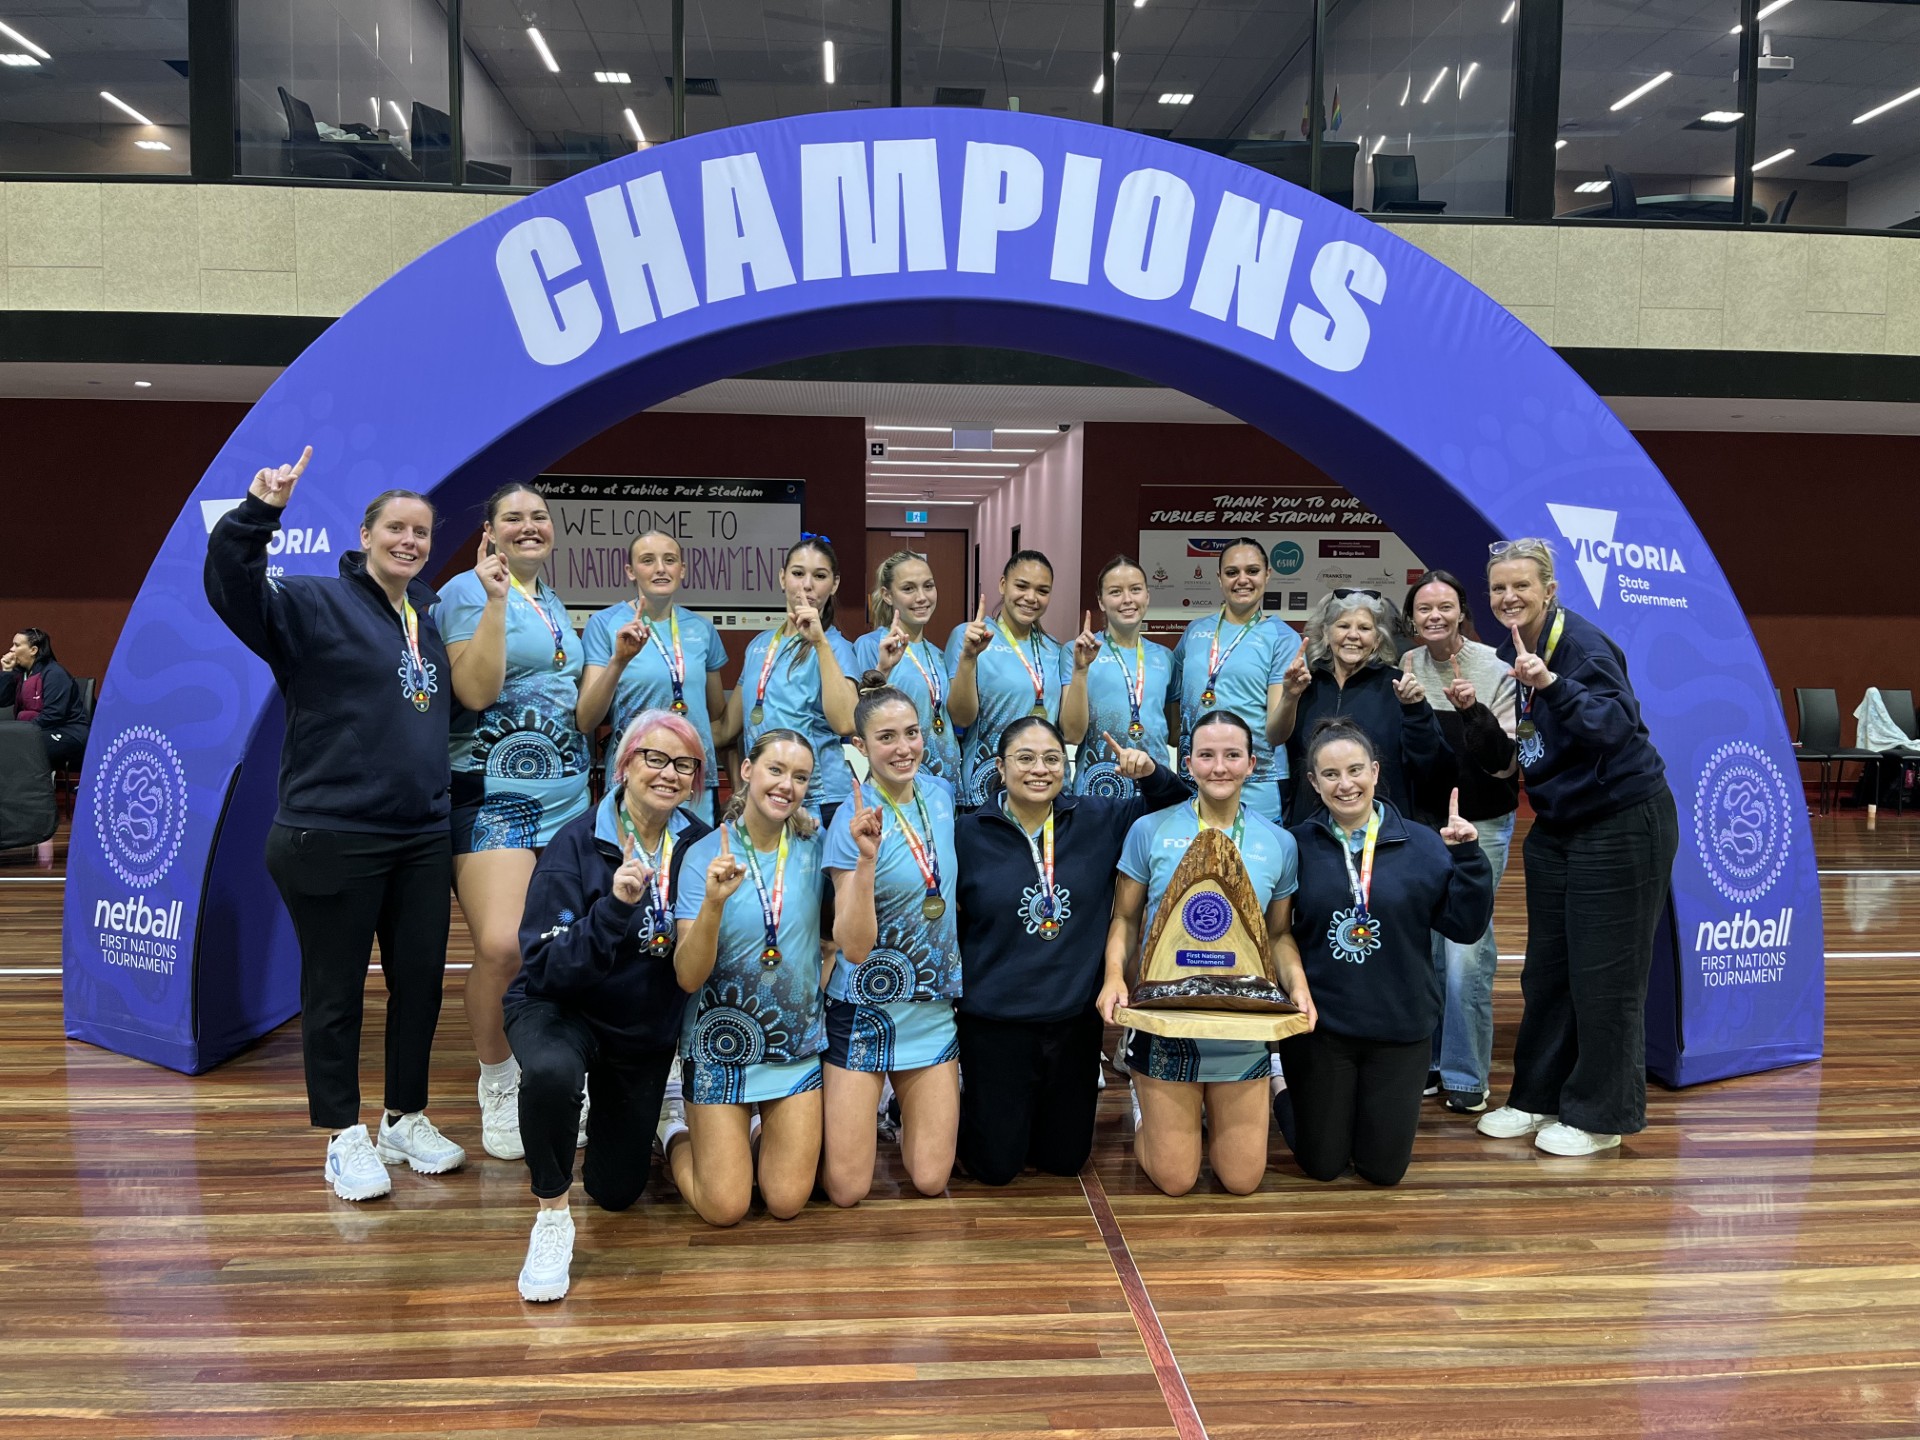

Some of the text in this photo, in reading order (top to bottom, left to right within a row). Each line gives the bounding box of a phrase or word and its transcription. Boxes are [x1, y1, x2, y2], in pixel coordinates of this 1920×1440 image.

[495, 138, 1387, 373] CHAMPIONS
[535, 483, 763, 497] What's On at Jubilee Park Stadium
[1213, 495, 1360, 509] THANK YOU TO OUR
[561, 507, 738, 540] WELCOME TO
[1150, 510, 1382, 525] JUBILEE PARK STADIUM PART
[266, 527, 331, 555] ORIA
[1563, 536, 1686, 574] VICTORIA
[266, 564, 284, 577] ate
[569, 547, 629, 588] NATION
[682, 546, 789, 593] URNAMENT
[1618, 574, 1650, 590] State
[1620, 589, 1688, 609] Government
[94, 895, 183, 940] netball
[1695, 907, 1793, 951] netball
[100, 933, 177, 960] FIRST NATIONS
[102, 949, 175, 976] TOURNAMENT
[1701, 951, 1786, 971] FIRST NATIONS
[1703, 967, 1783, 987] TOURNAMENT
